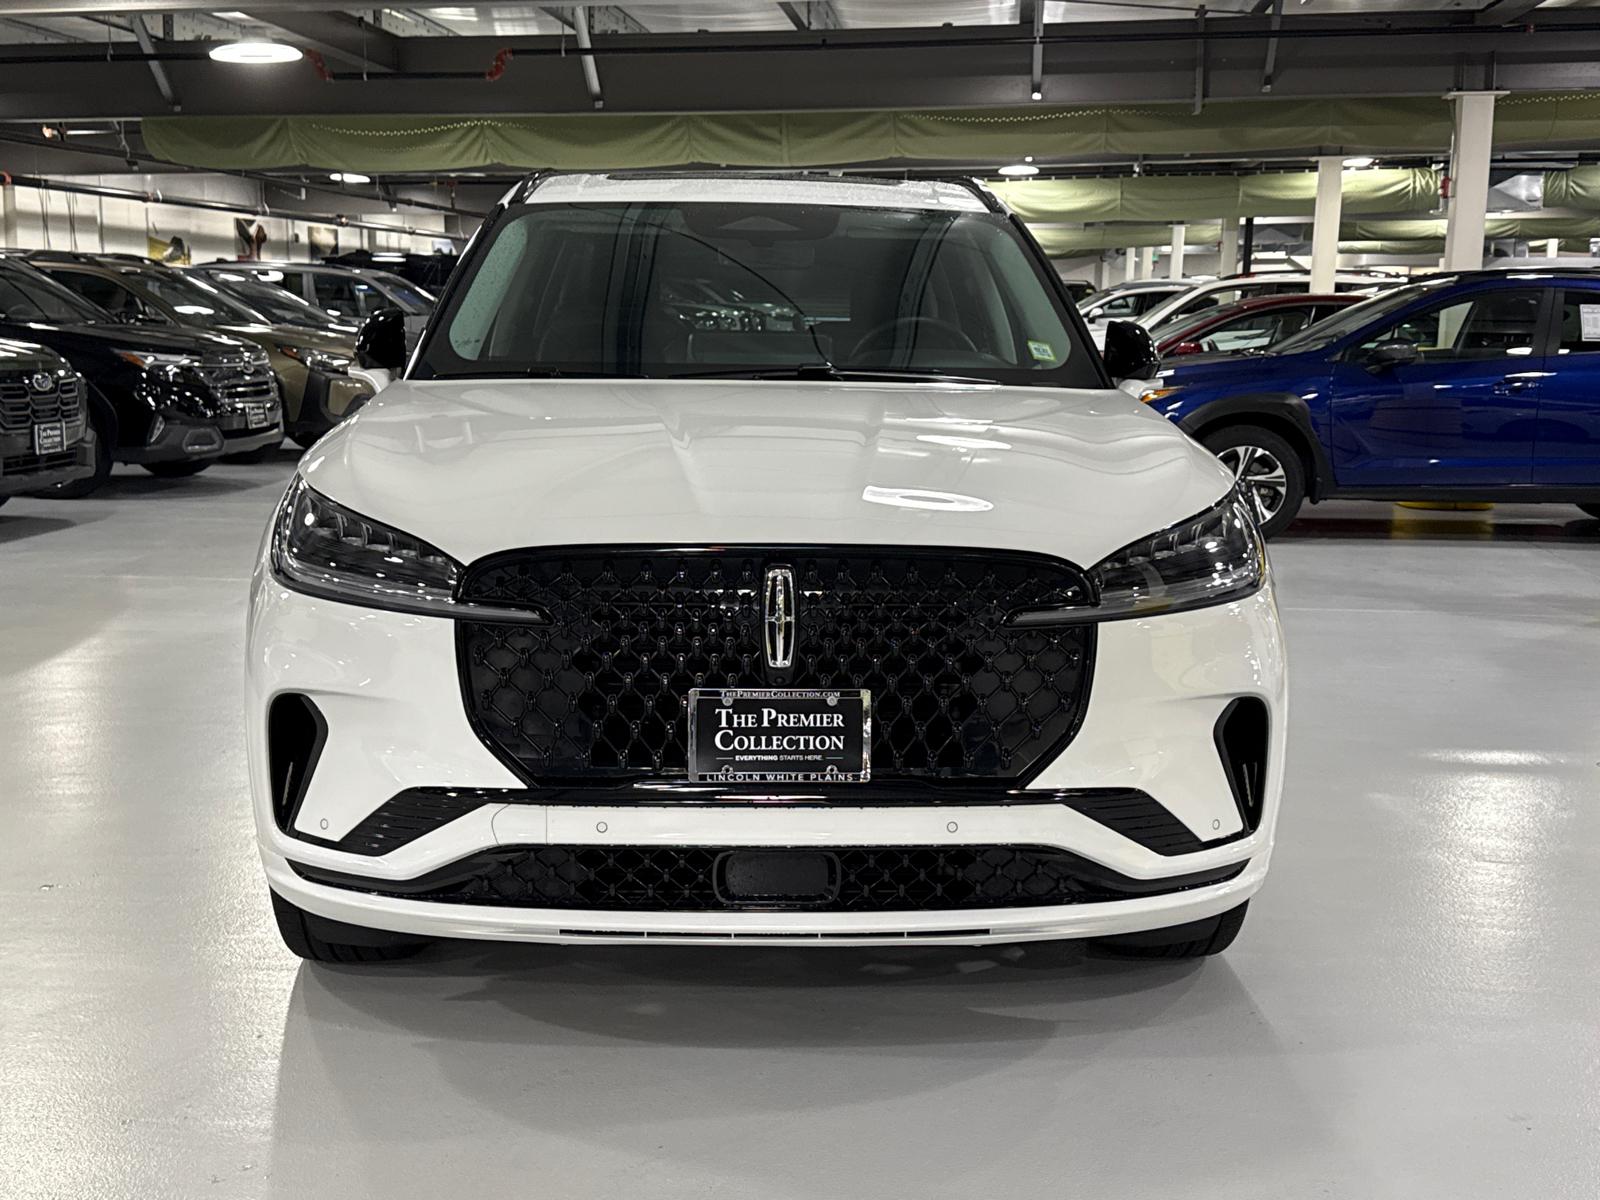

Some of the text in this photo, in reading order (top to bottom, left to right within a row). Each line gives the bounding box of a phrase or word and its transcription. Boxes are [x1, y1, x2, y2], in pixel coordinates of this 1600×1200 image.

[714, 708, 845, 728] THE PREMIER
[714, 730, 845, 751] COLLECTION
